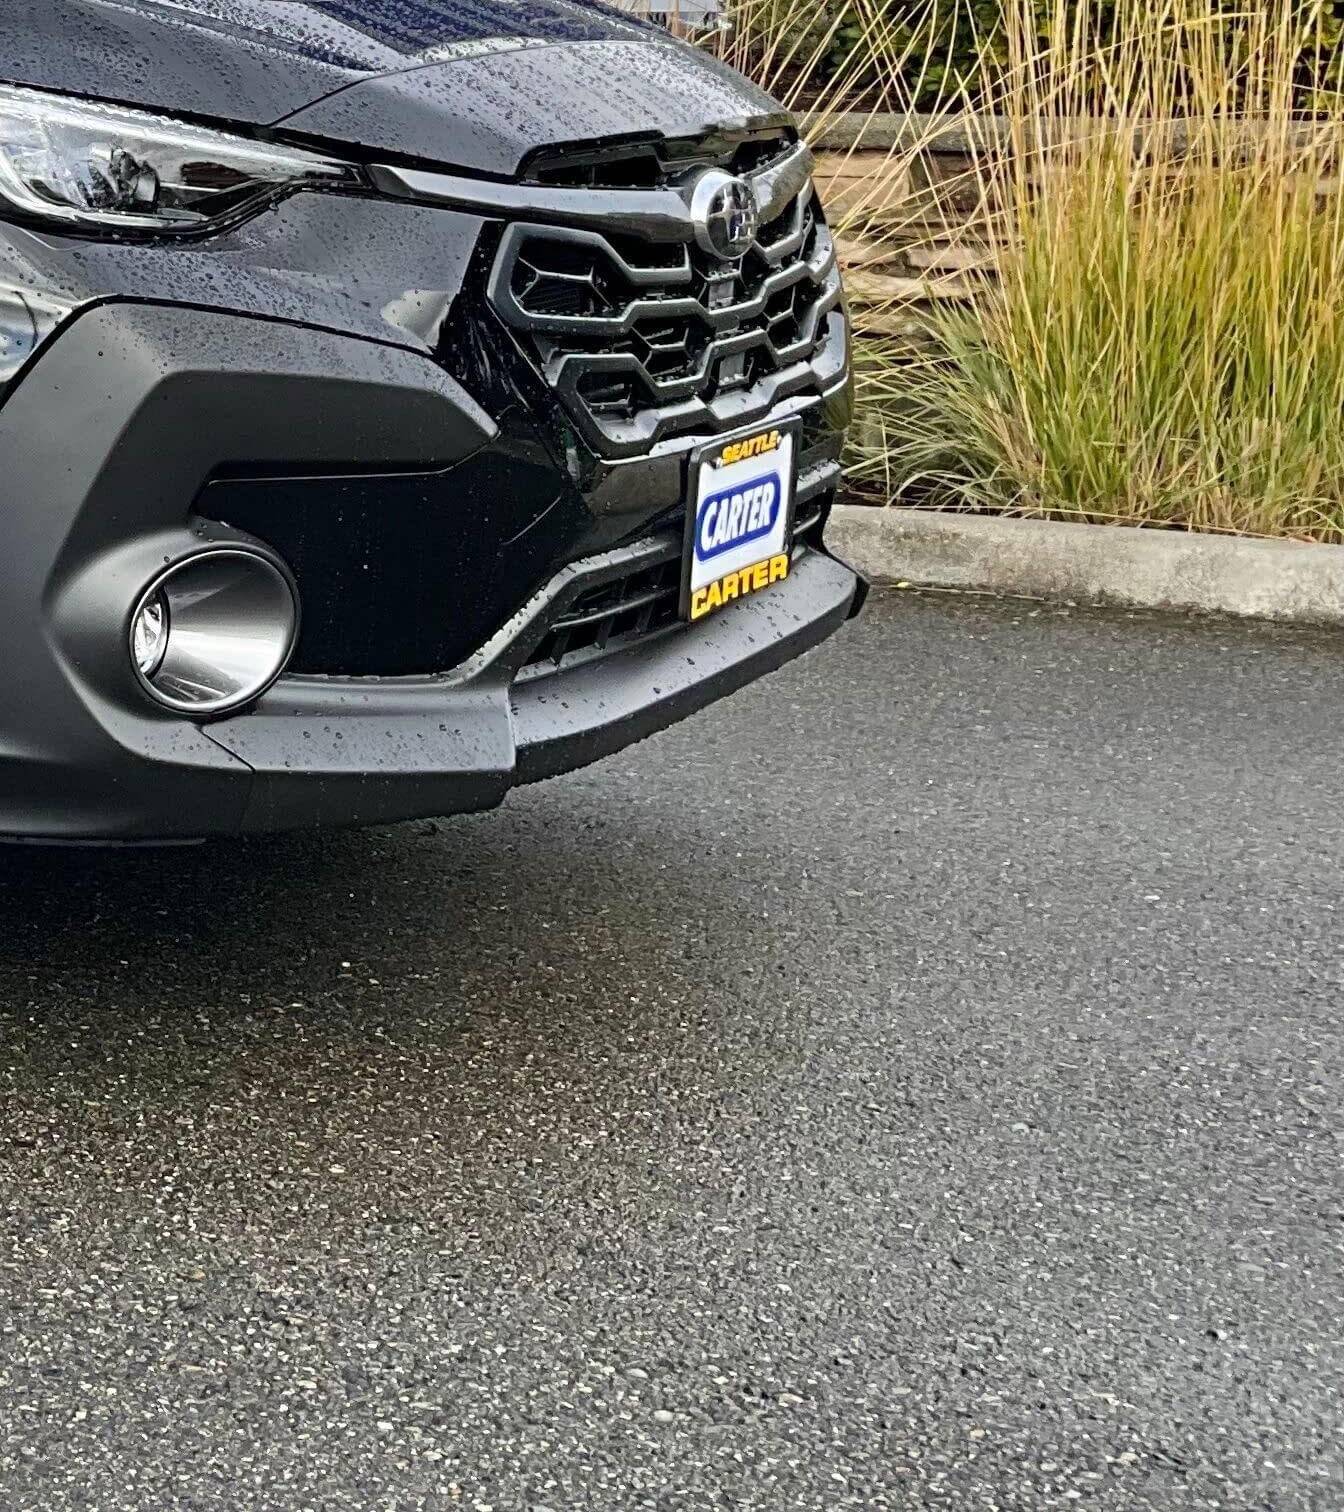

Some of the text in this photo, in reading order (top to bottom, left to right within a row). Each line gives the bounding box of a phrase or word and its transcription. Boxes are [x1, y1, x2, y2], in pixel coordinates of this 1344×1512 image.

[722, 430, 780, 464] SEATTLE
[701, 481, 776, 552] CARTER
[690, 554, 789, 620] CARTER
